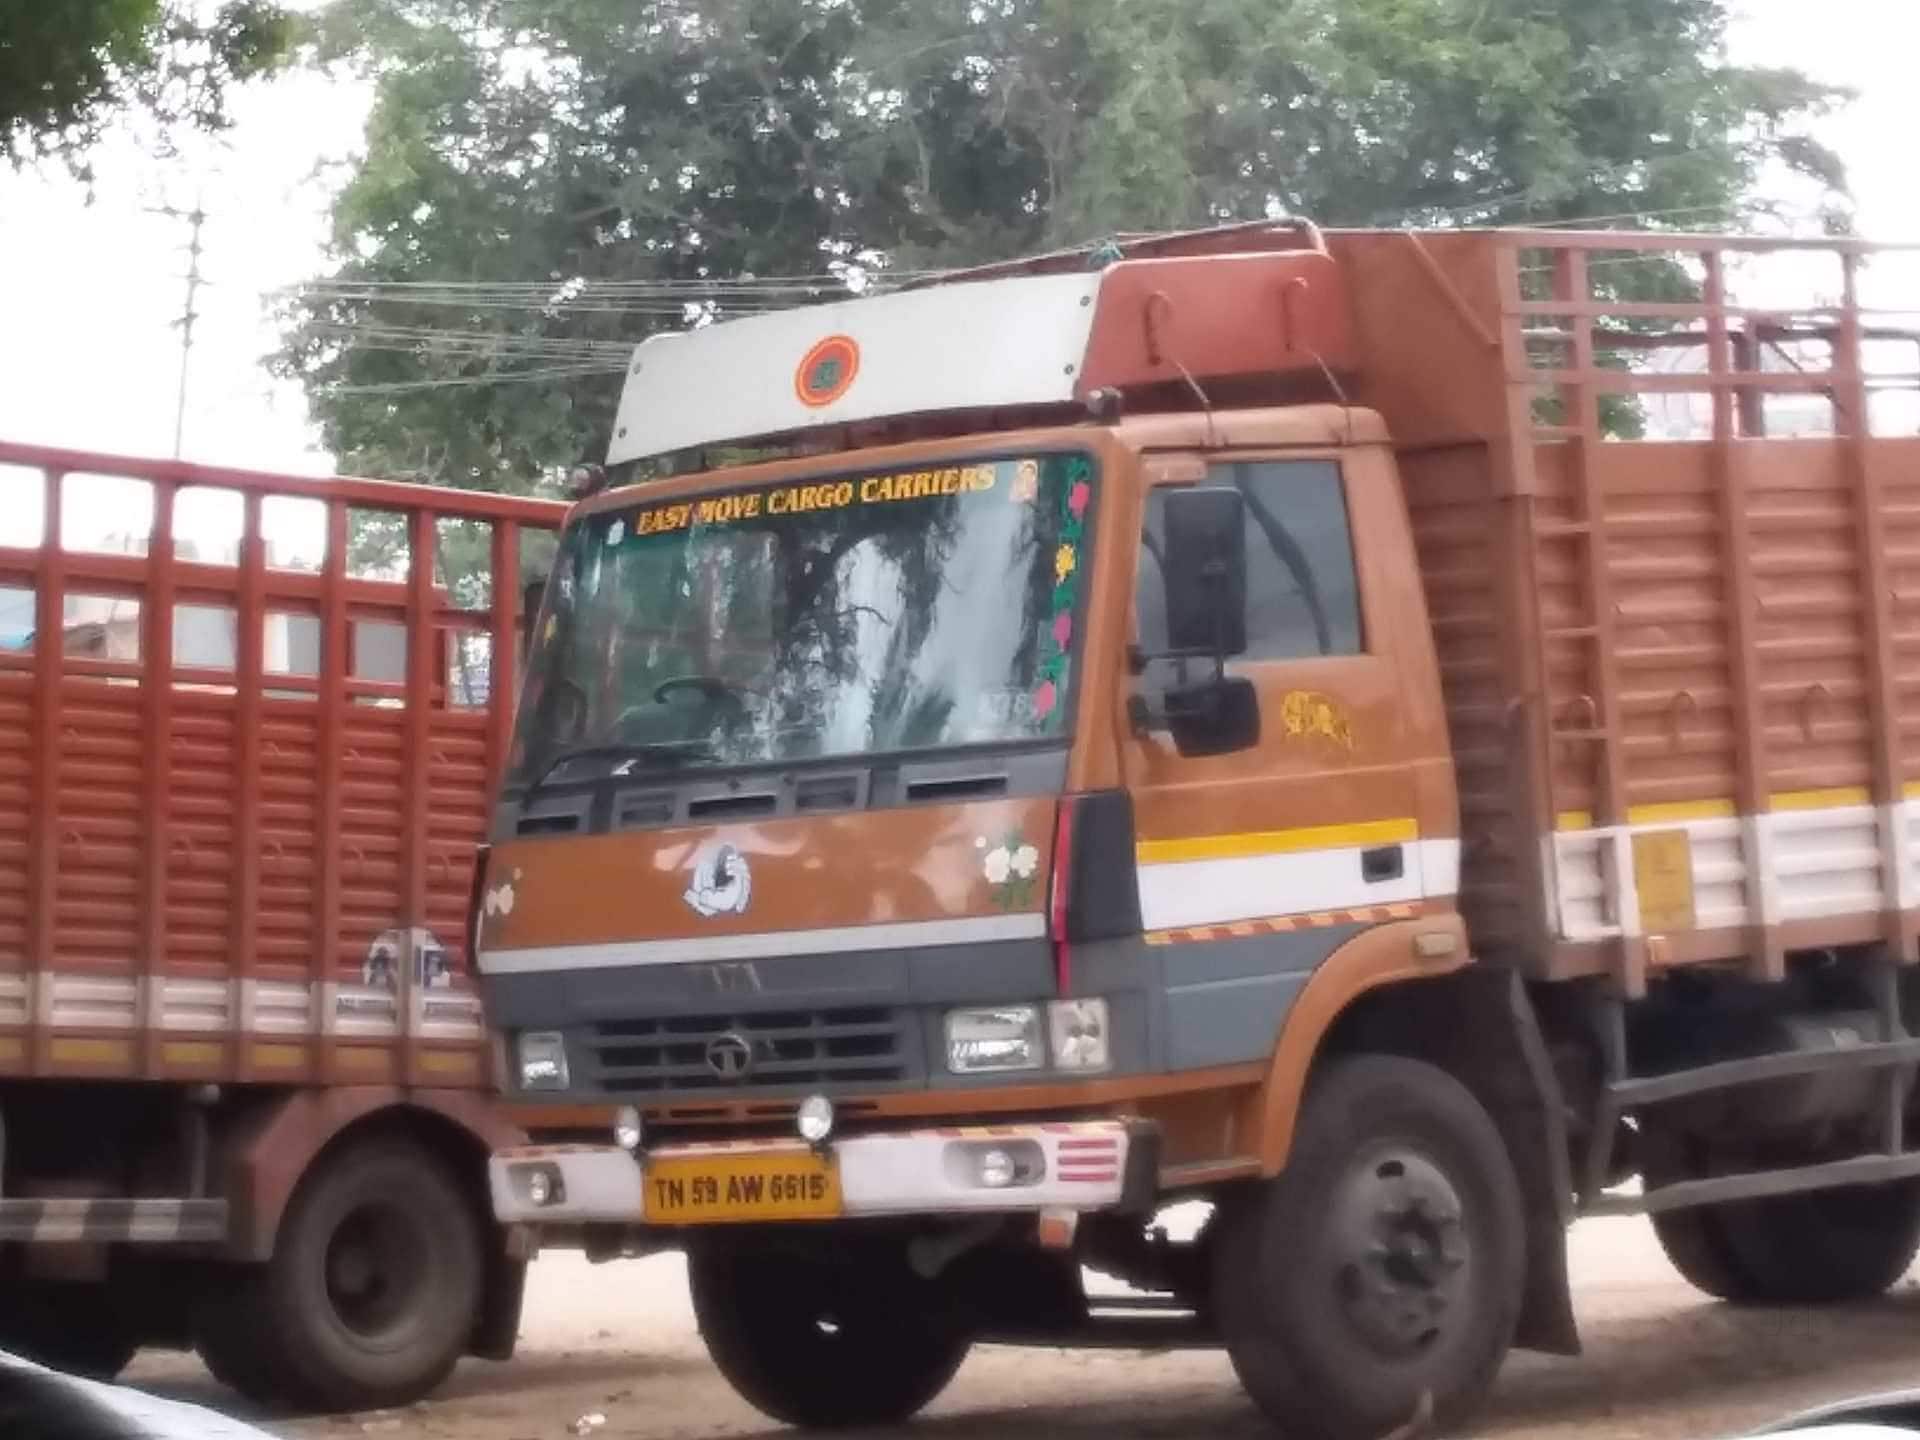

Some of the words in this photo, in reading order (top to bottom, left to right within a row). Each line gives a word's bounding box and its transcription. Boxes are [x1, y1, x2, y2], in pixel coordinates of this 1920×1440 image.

[699, 494, 762, 524] MOVE
[767, 482, 852, 515] CARGO
[860, 465, 996, 503] CARRIERS
[655, 1178, 684, 1208] TN
[726, 1173, 764, 1204] AW
